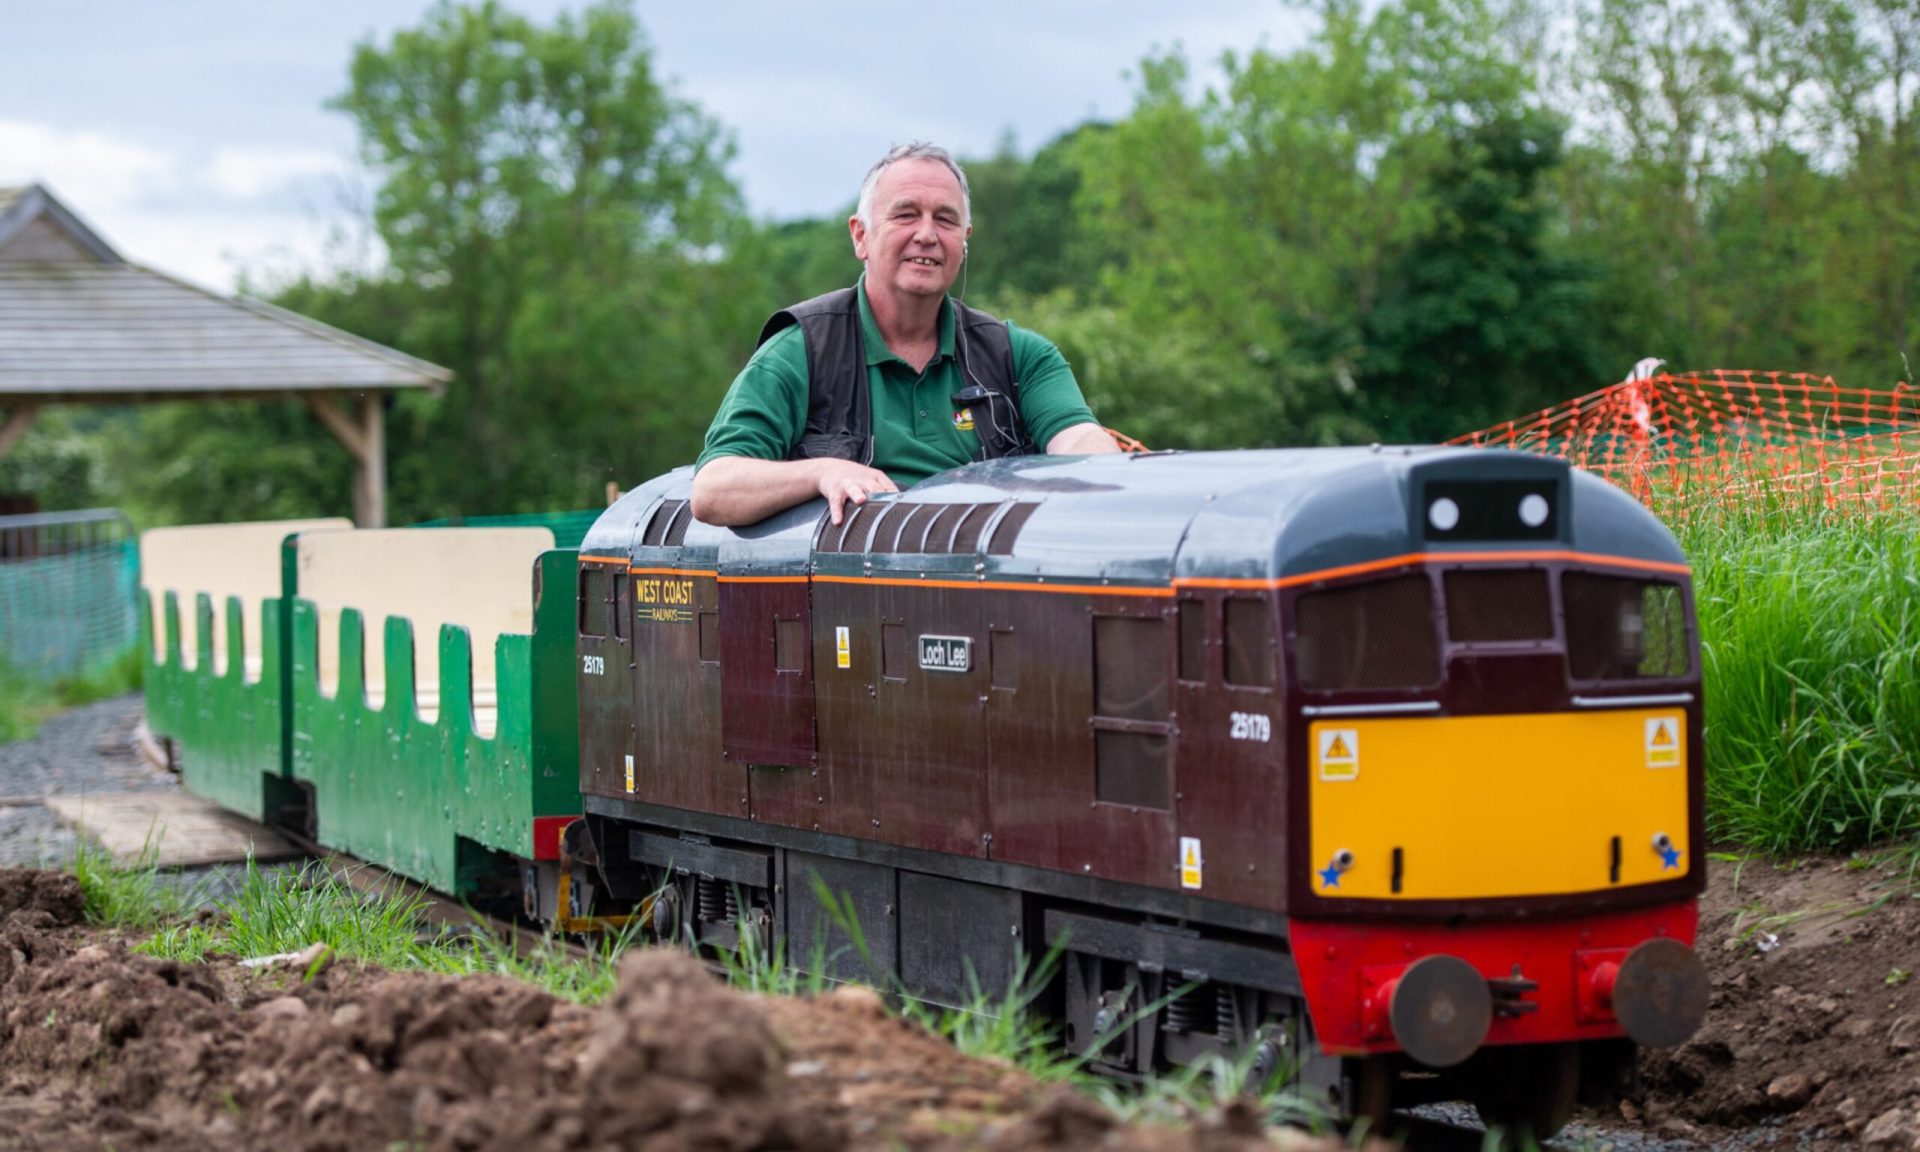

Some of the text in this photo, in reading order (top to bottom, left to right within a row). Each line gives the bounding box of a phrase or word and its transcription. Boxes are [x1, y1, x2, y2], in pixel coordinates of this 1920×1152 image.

[636, 580, 693, 605] WEST COAST
[583, 655, 604, 675] 25179
[921, 640, 966, 667] Loch Lee
[1230, 711, 1271, 742] 25179
